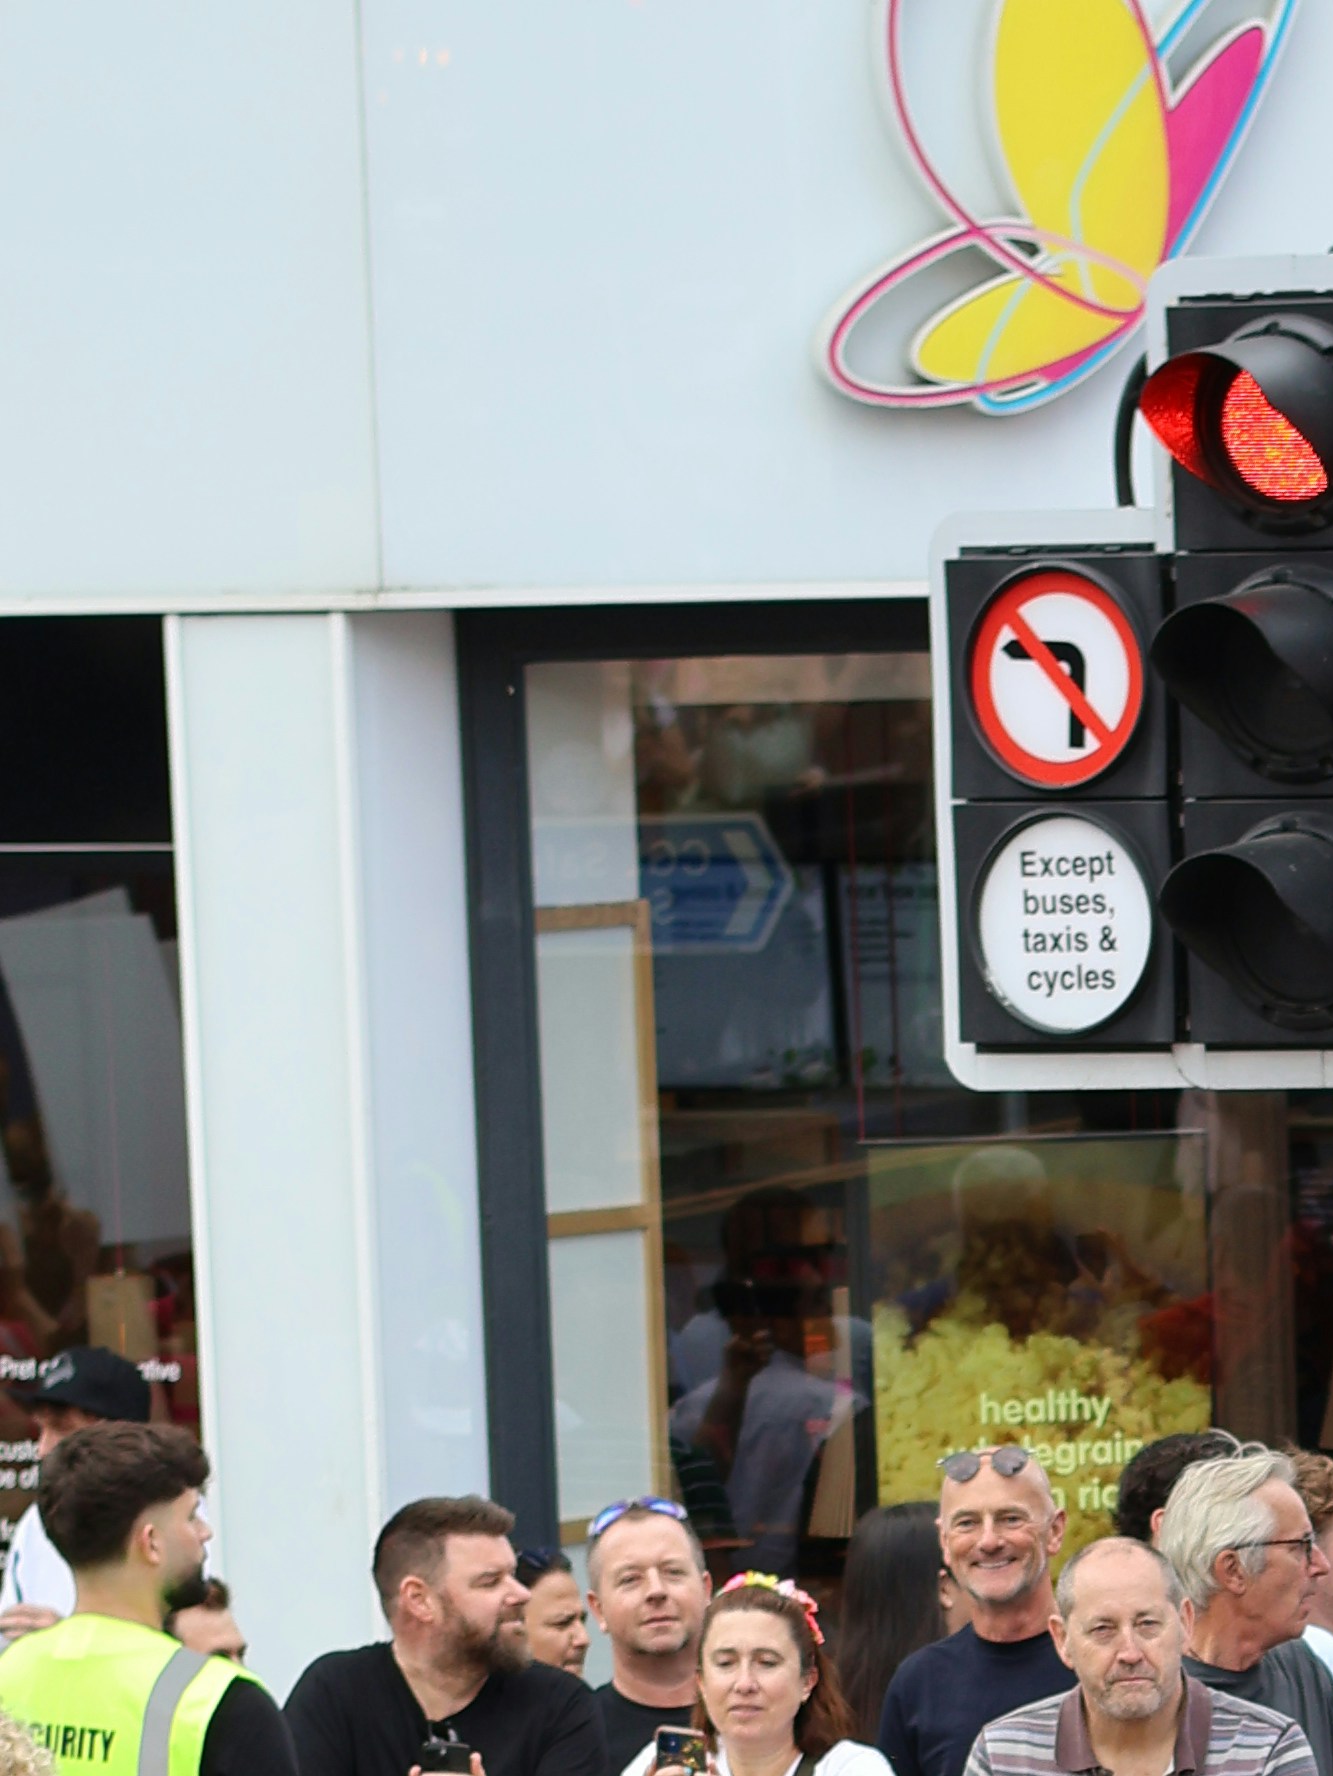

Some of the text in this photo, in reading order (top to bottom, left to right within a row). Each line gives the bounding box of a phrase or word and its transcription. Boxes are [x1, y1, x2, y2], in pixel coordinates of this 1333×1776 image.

[1019, 850, 1116, 883] Except
[1022, 888, 1116, 919] buses,
[1022, 924, 1118, 954] taxis &
[1026, 963, 1117, 998] cycles
[979, 1388, 1112, 1430] healthy
[27, 1721, 117, 1764] CURITY
